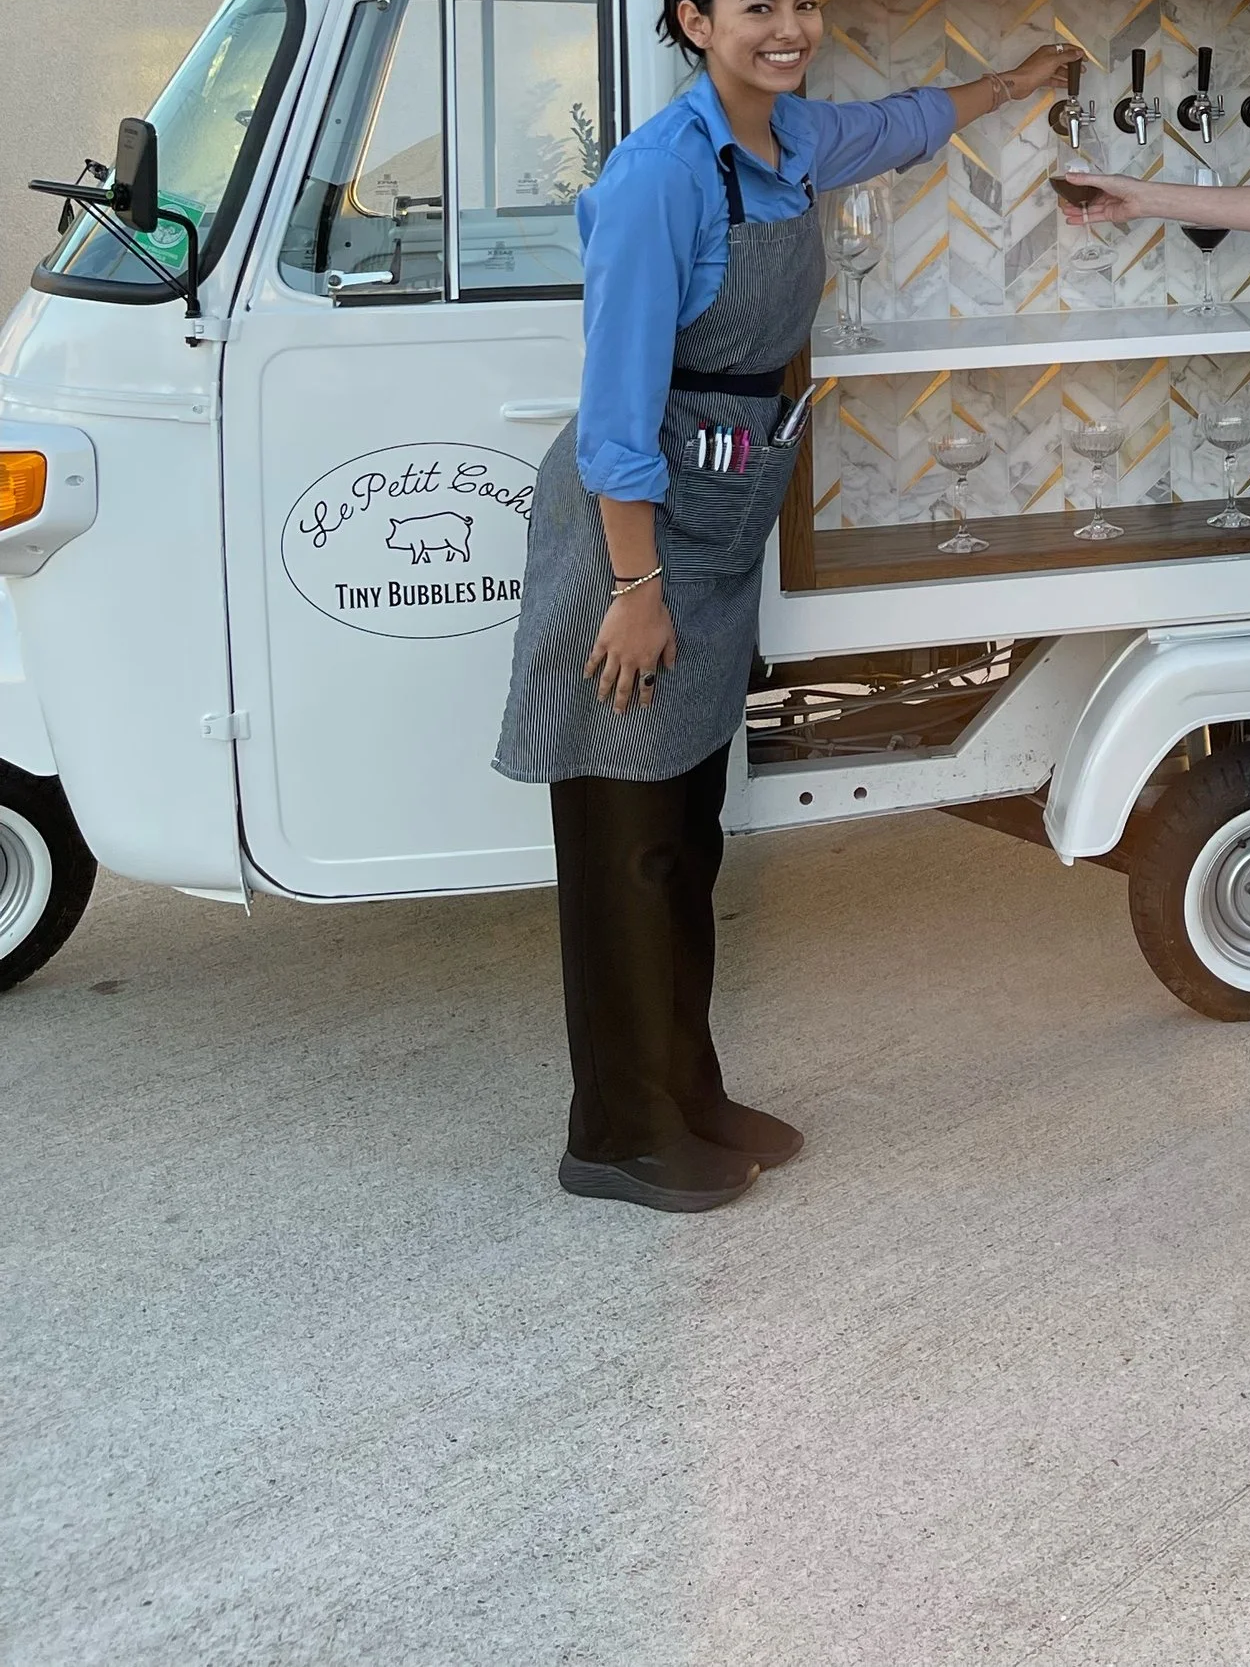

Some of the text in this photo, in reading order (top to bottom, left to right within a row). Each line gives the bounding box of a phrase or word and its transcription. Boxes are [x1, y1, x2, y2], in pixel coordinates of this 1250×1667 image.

[300, 462, 533, 548] Le Petit Coch
[335, 576, 522, 610] TINY BUBBLES BAR
